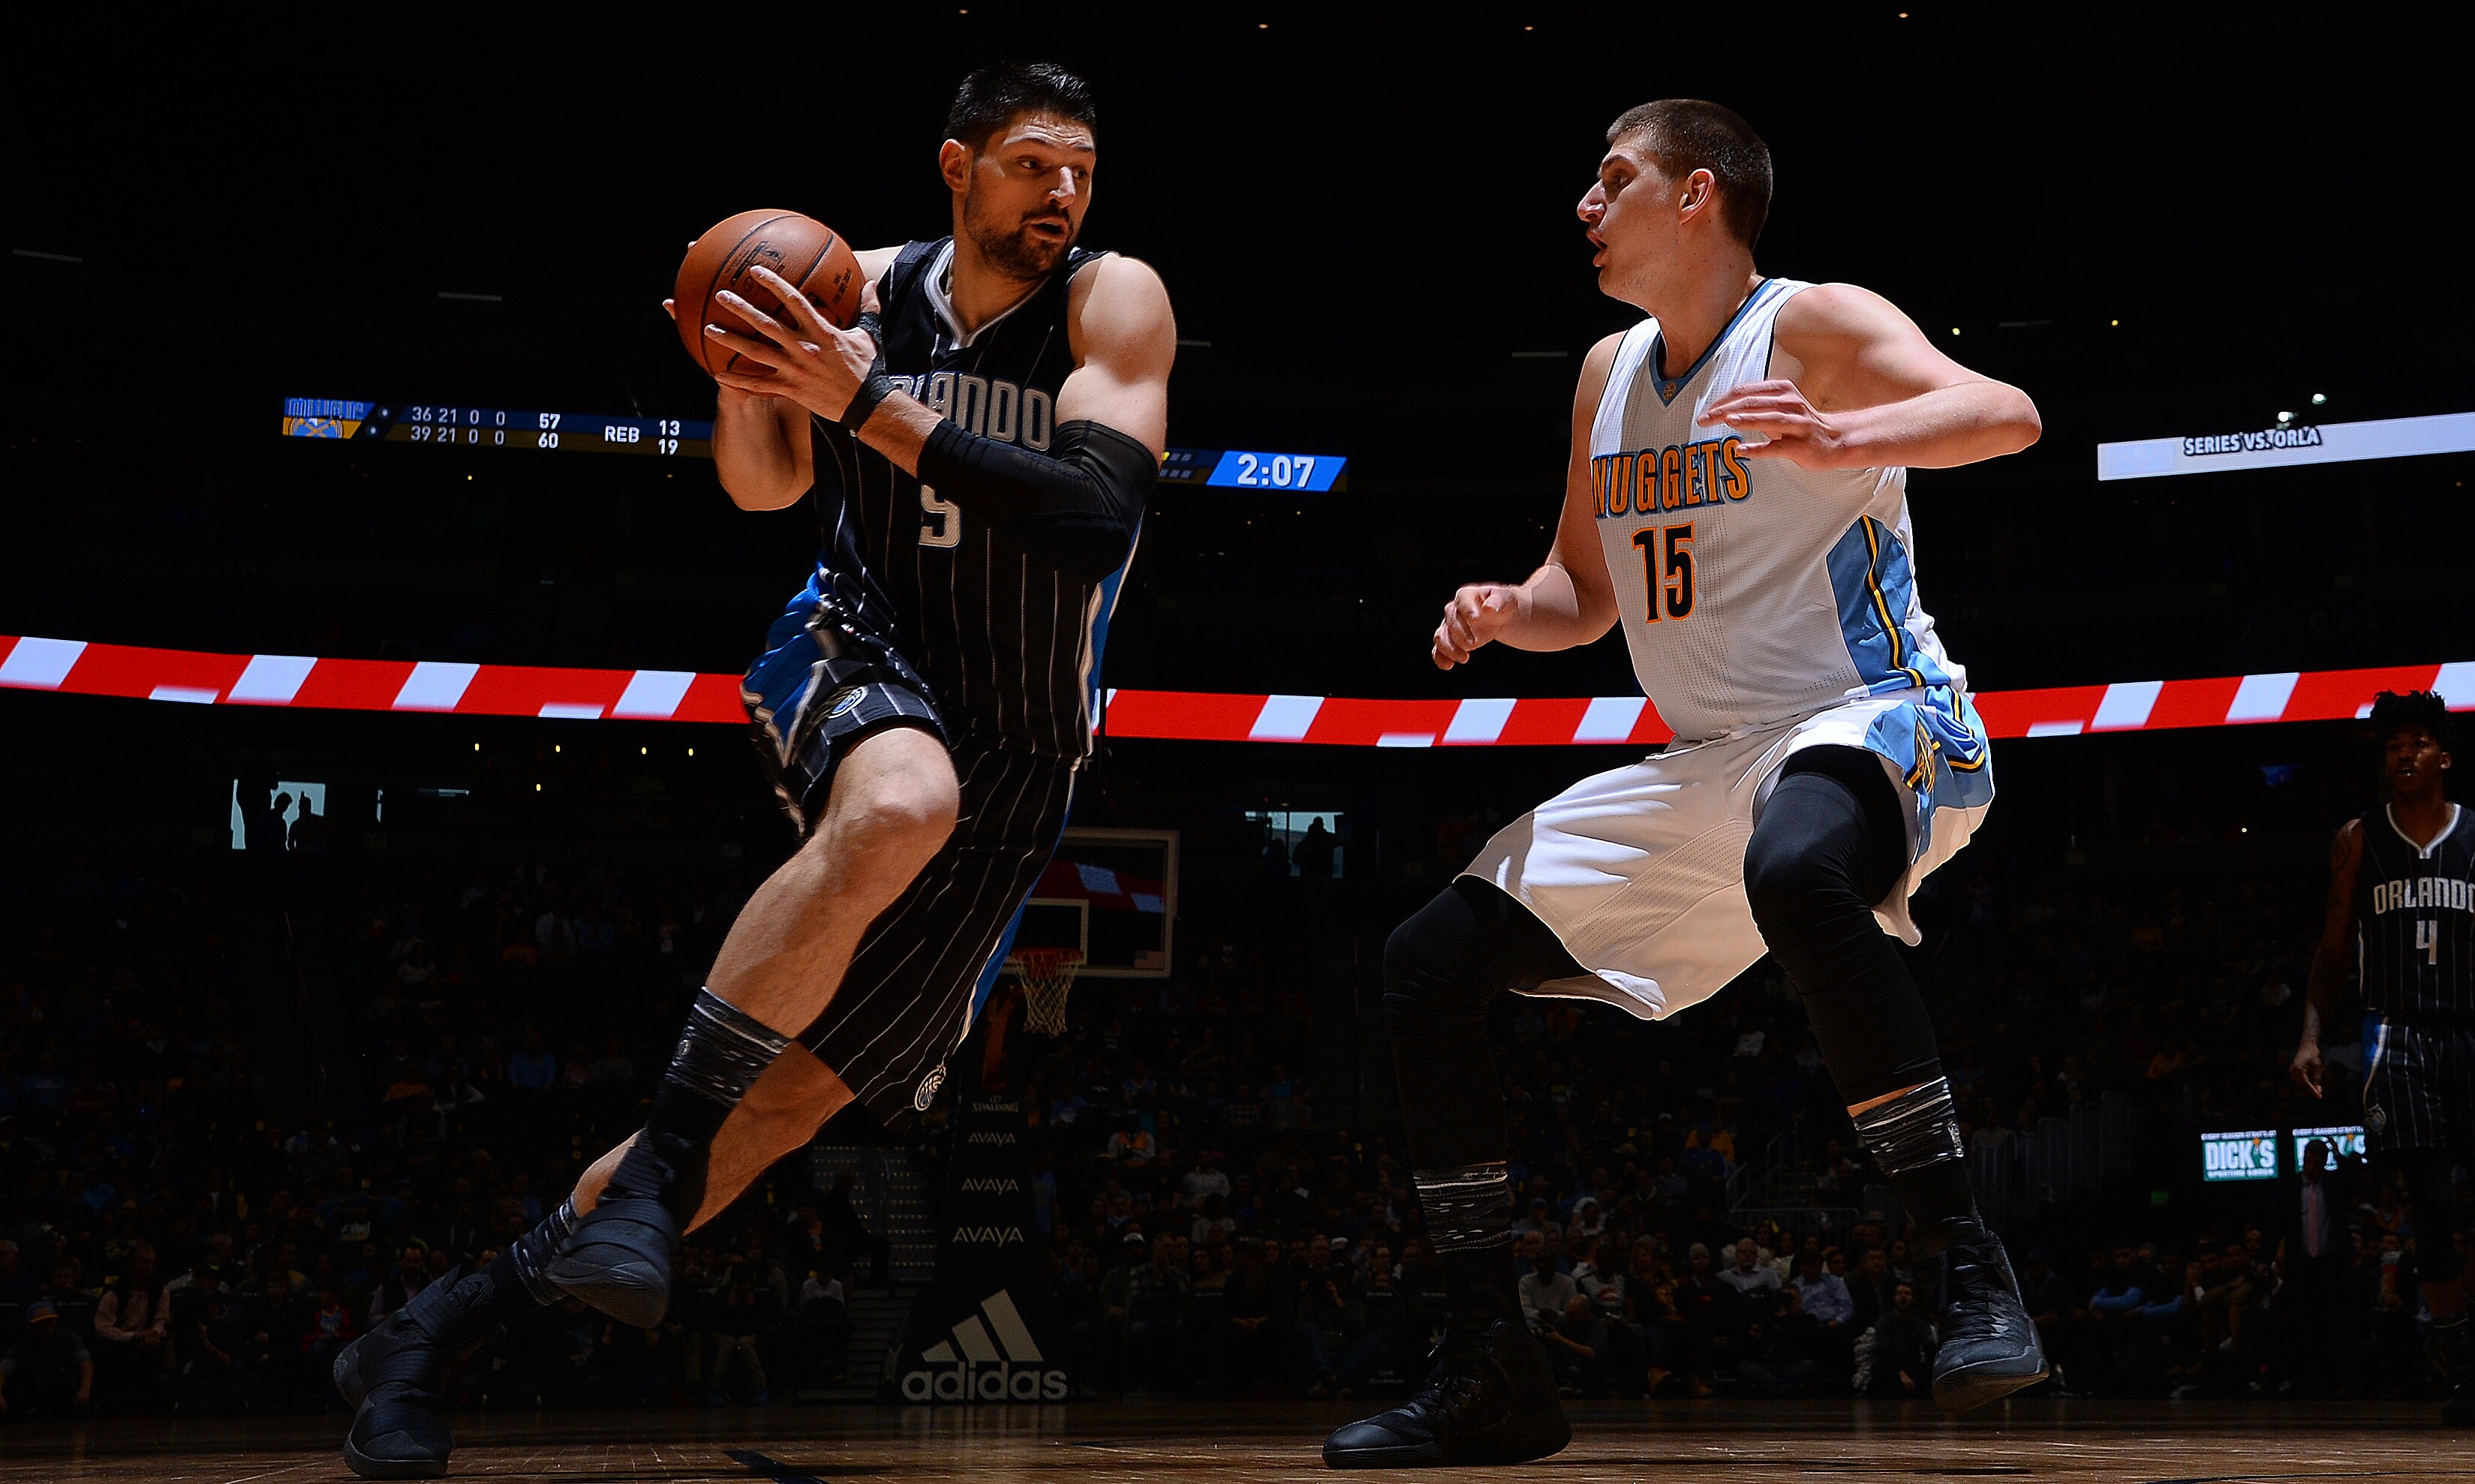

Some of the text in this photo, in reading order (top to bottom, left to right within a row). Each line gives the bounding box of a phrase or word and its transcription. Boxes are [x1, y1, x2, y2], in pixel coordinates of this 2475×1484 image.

[412, 406, 561, 430] 36 21 0 0 57
[659, 420, 680, 436] 13
[410, 425, 559, 449] 39 21 0 0 60
[605, 425, 640, 443] REB
[2185, 428, 2321, 455] SERIES VS. ORLA
[658, 439, 678, 455] 19
[1238, 453, 1315, 488] 2:07
[1592, 436, 1751, 518] NUGGETS
[1631, 521, 1695, 623] 15
[2416, 920, 2437, 965] 4
[968, 1131, 1016, 1146] AVAYA
[2205, 1140, 2275, 1170] DICK'S
[961, 1177, 1020, 1196] AVAYA
[952, 1226, 1024, 1248] AVAYA
[901, 1360, 1068, 1401] adidas
